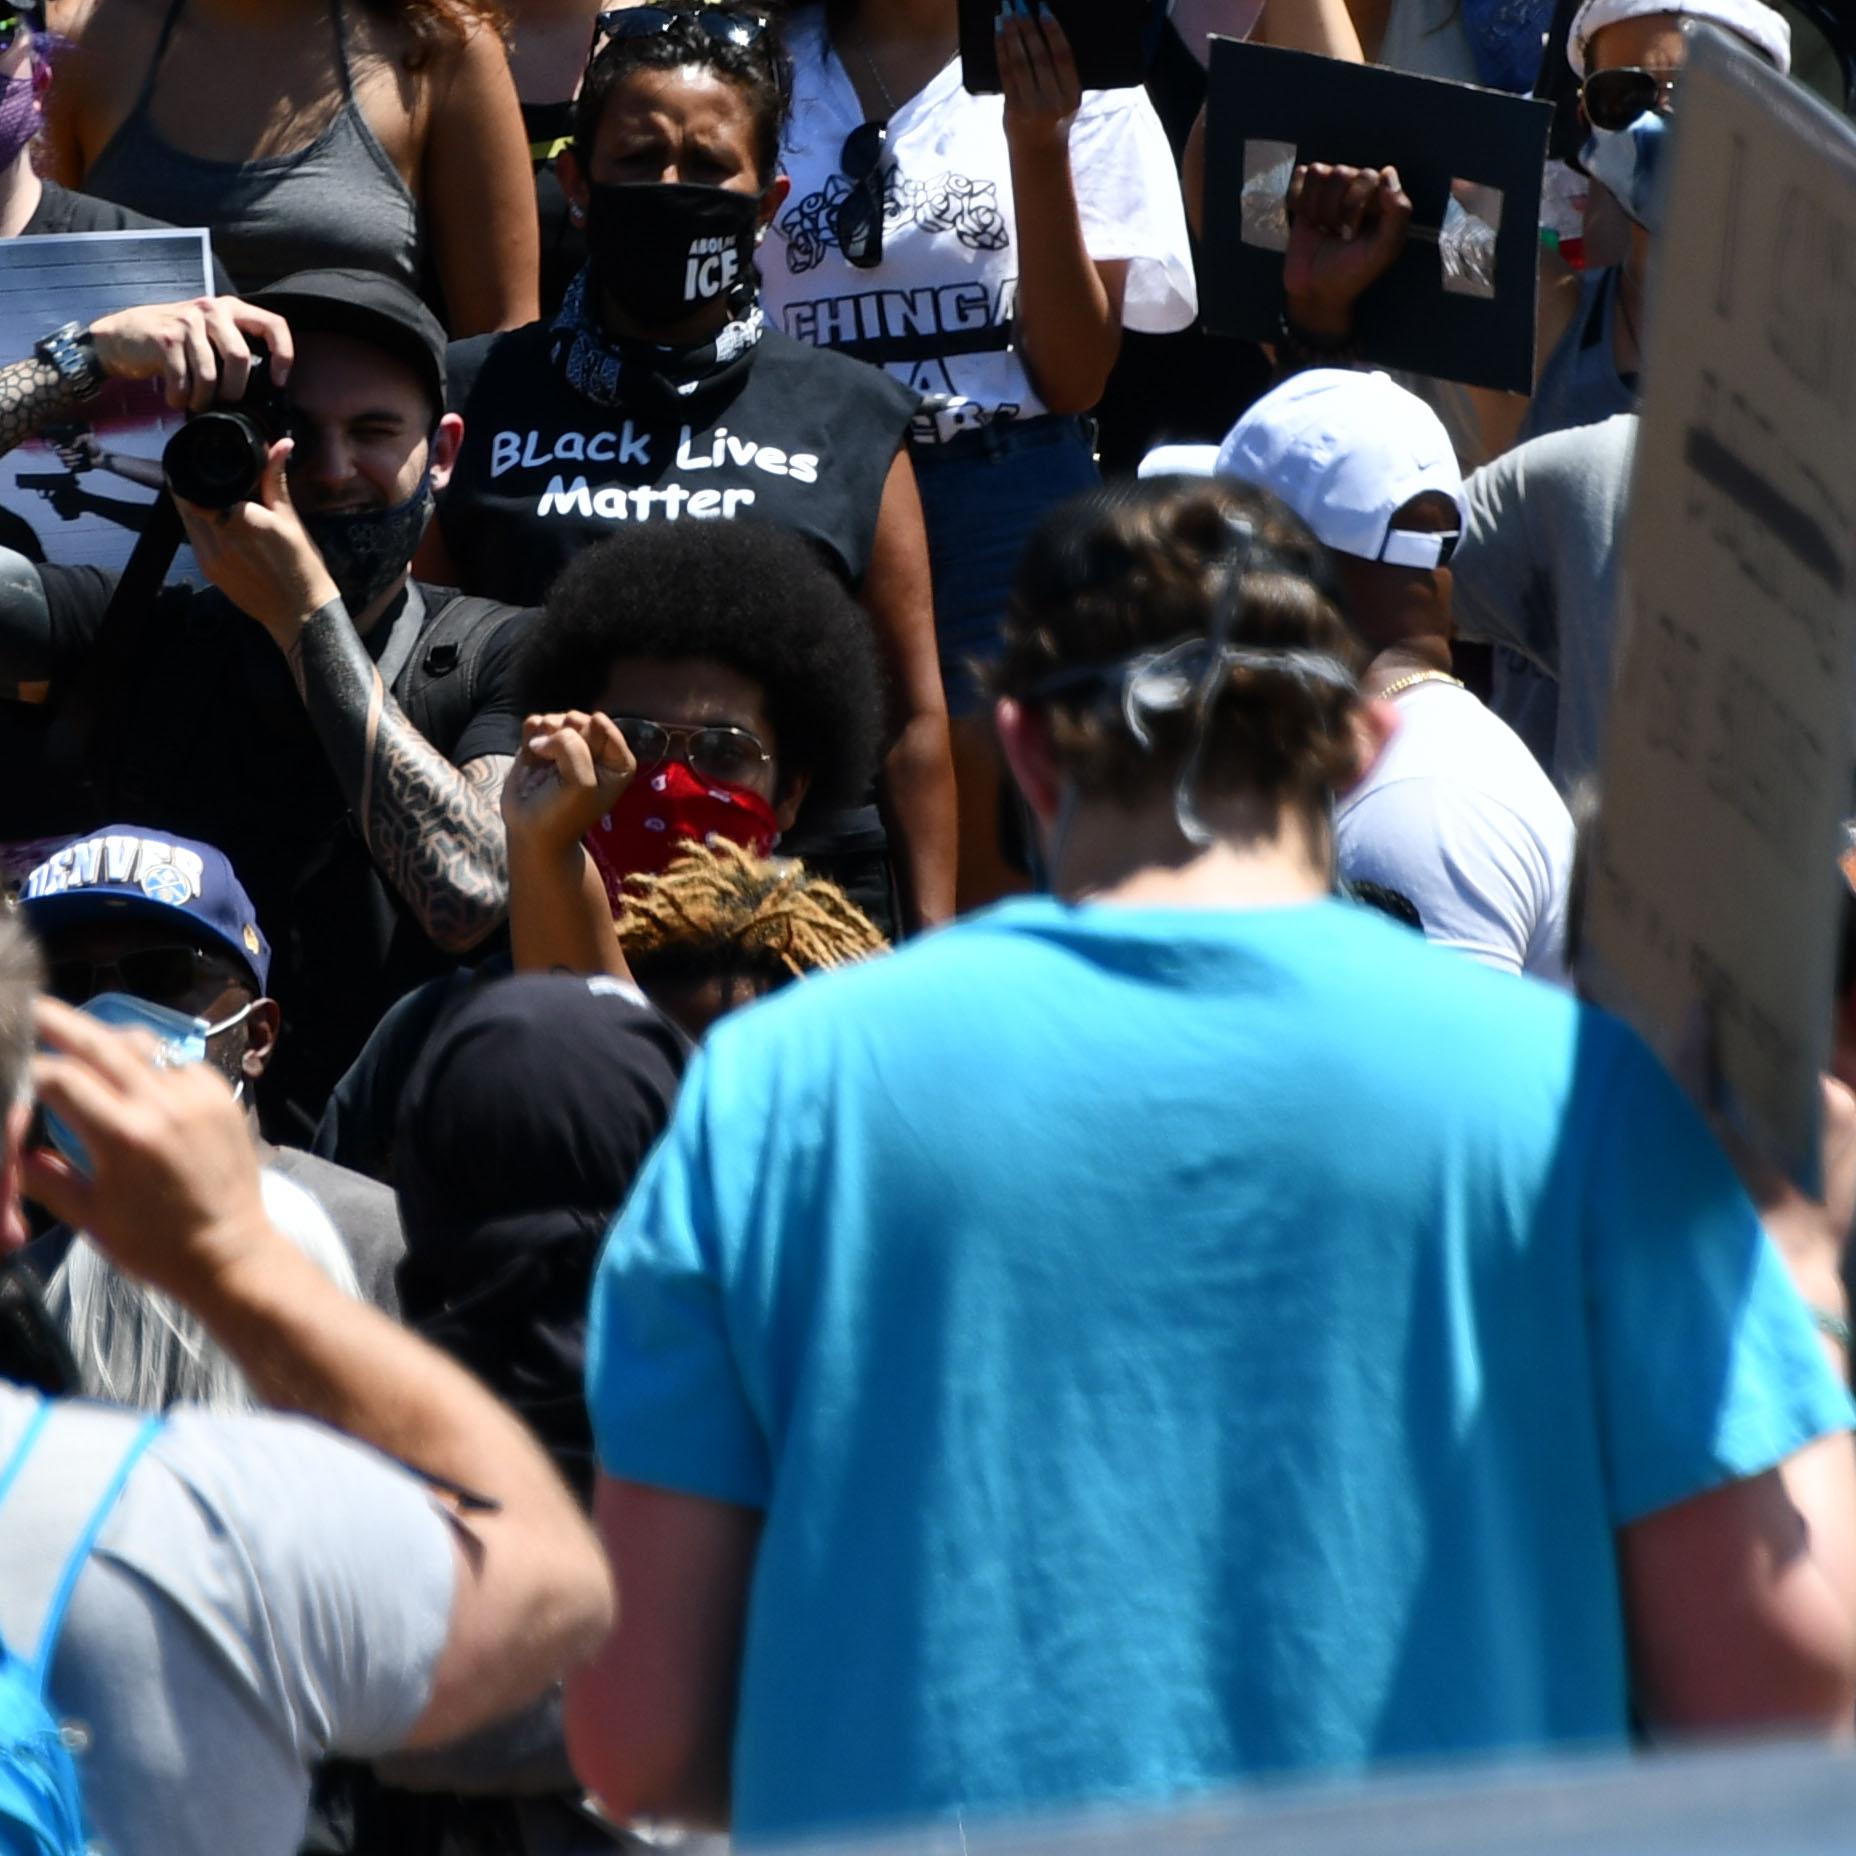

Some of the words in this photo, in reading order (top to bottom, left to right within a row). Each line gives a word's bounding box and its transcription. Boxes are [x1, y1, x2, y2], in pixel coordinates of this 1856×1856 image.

[684, 248, 739, 301] ICE
[675, 425, 820, 484] Lives
[536, 474, 756, 522] Matter
